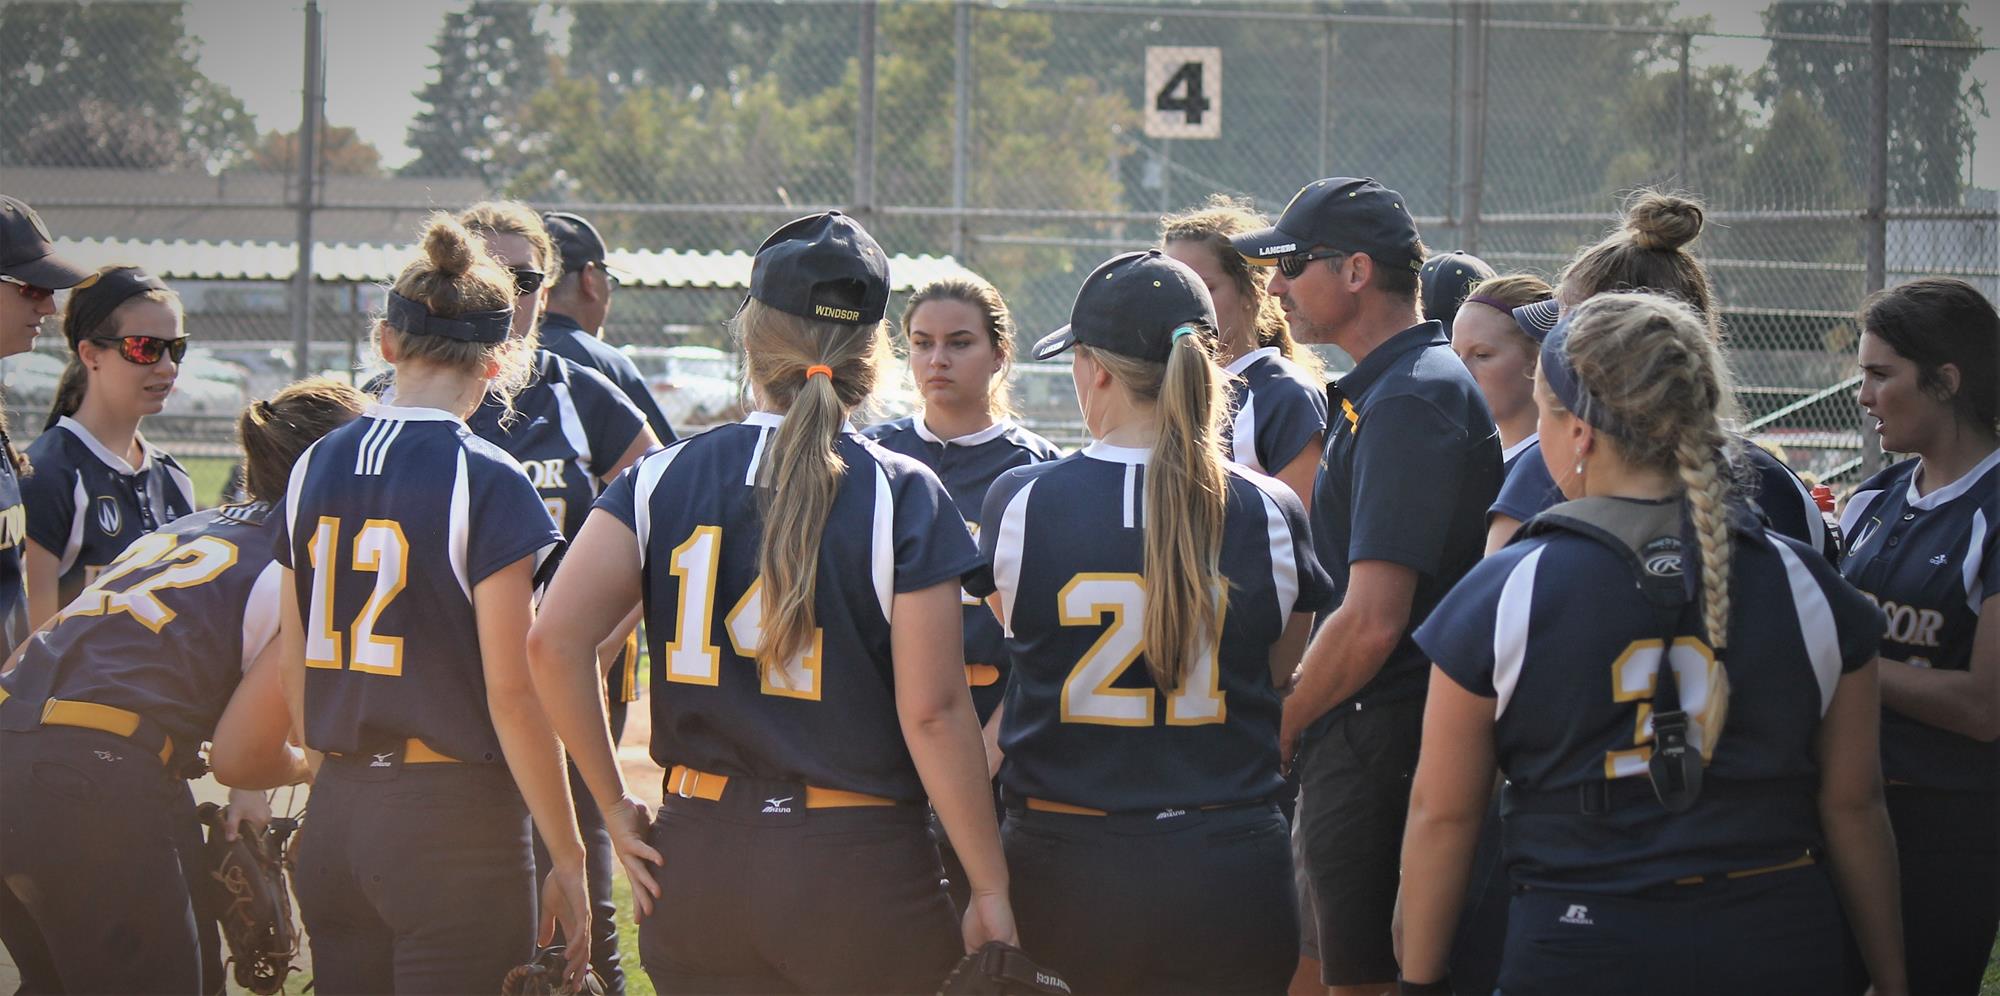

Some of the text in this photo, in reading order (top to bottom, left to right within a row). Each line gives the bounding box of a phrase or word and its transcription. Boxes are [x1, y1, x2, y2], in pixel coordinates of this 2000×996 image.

[1156, 61, 1210, 125] 4
[1258, 243, 1297, 256] LANCERS
[815, 304, 860, 321] WINDSOR
[57, 532, 239, 634] 22
[305, 515, 410, 677] 12
[665, 525, 823, 701] 14
[1057, 572, 1229, 727] 21
[1605, 635, 1716, 780] 3
